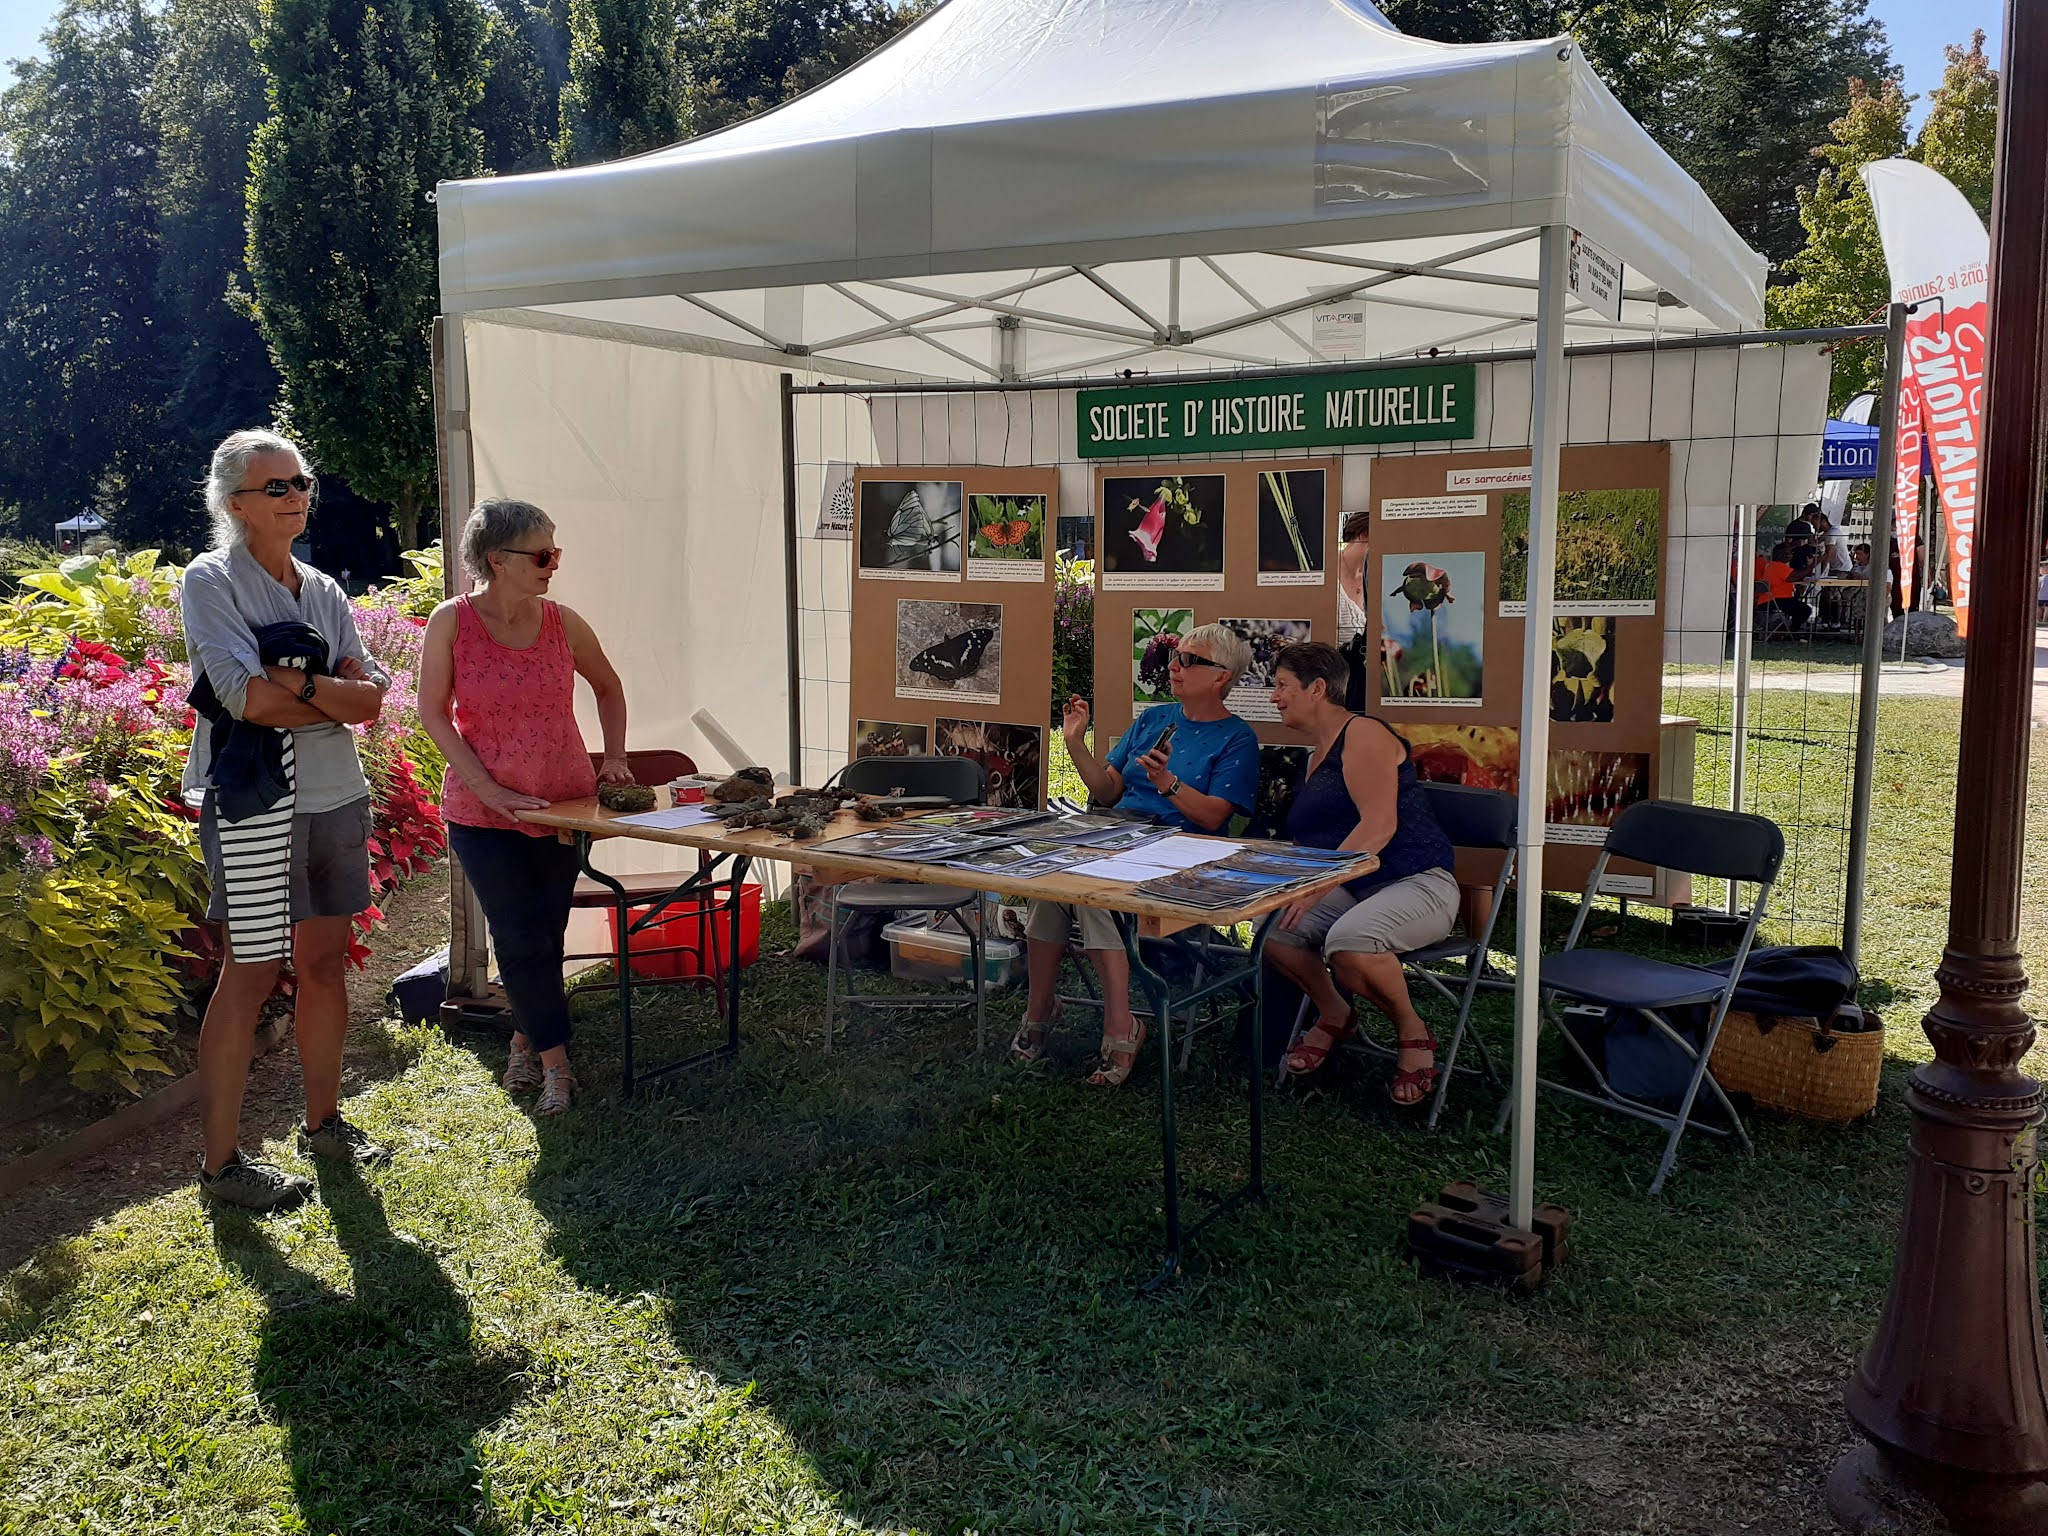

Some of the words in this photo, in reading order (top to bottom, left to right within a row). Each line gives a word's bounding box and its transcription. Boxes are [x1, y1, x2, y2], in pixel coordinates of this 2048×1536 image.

[1090, 402, 1170, 442] SOCIETE
[1325, 384, 1456, 429] NATURELLE
[1454, 476, 1470, 484] Les
[1475, 472, 1532, 484] sarracénies
